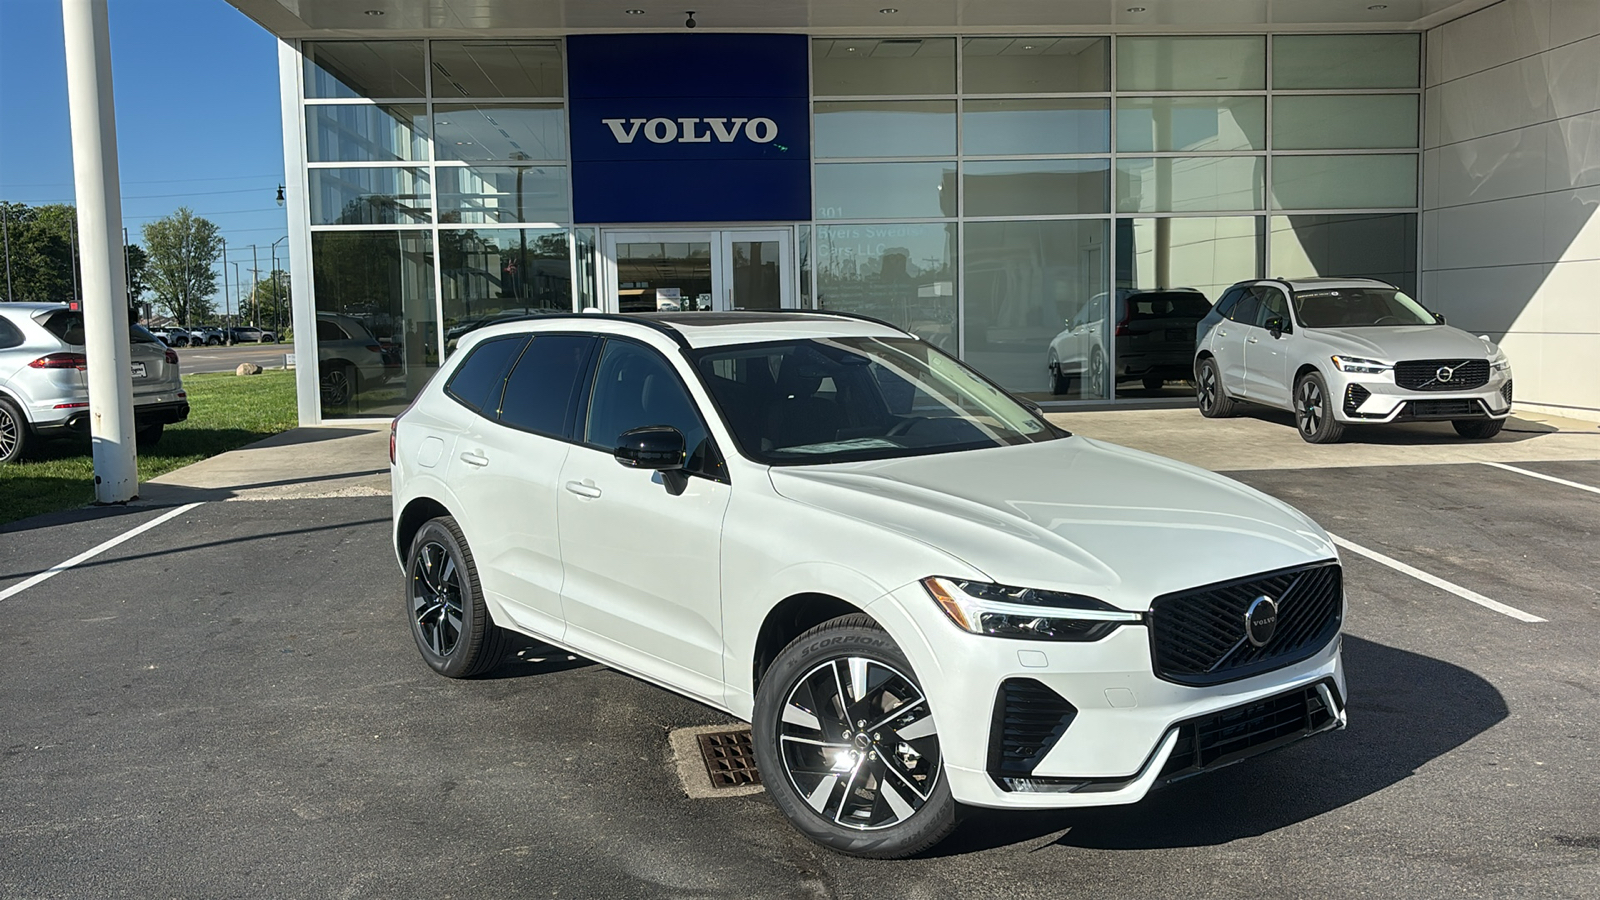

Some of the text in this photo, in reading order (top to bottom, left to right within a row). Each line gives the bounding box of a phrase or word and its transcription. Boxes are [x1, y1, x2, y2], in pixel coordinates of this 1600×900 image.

[602, 117, 778, 143] VOLVO
[818, 207, 842, 218] 301
[858, 243, 886, 256] LLC
[1253, 616, 1275, 626] VOLVO
[801, 635, 885, 658] SCORPION
